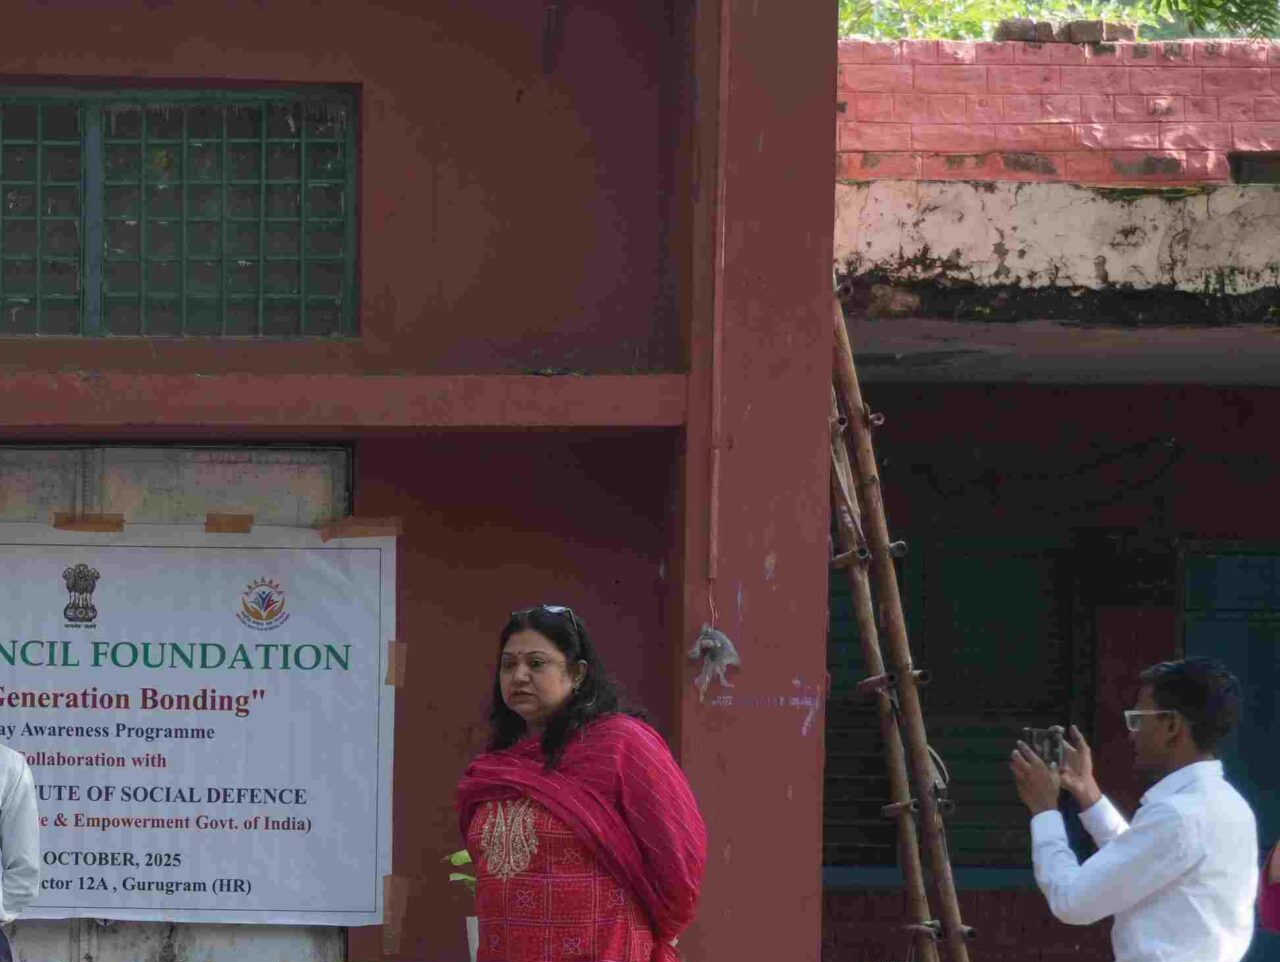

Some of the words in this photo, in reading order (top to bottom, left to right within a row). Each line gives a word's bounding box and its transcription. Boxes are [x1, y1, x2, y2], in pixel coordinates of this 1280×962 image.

[90, 641, 351, 671] FOUNDATION
[140, 687, 265, 717] Bonding"
[21, 721, 109, 738] Awareness
[115, 723, 215, 741] Programme
[132, 753, 167, 768] with
[35, 785, 80, 801] UTE
[87, 785, 116, 802] OF
[120, 786, 201, 803] SOCIAL
[206, 788, 308, 805] DEFENCE
[54, 812, 69, 827] &
[74, 813, 189, 832] Empowerment
[195, 814, 238, 830] Govt.
[244, 815, 260, 830] of
[264, 816, 312, 833] India)
[43, 851, 140, 869] OCTOBER,
[145, 853, 181, 867] 2025
[41, 877, 72, 891] ctor
[78, 877, 108, 891] 12A
[122, 877, 206, 895] Gurugram
[212, 879, 252, 895] (HR)
